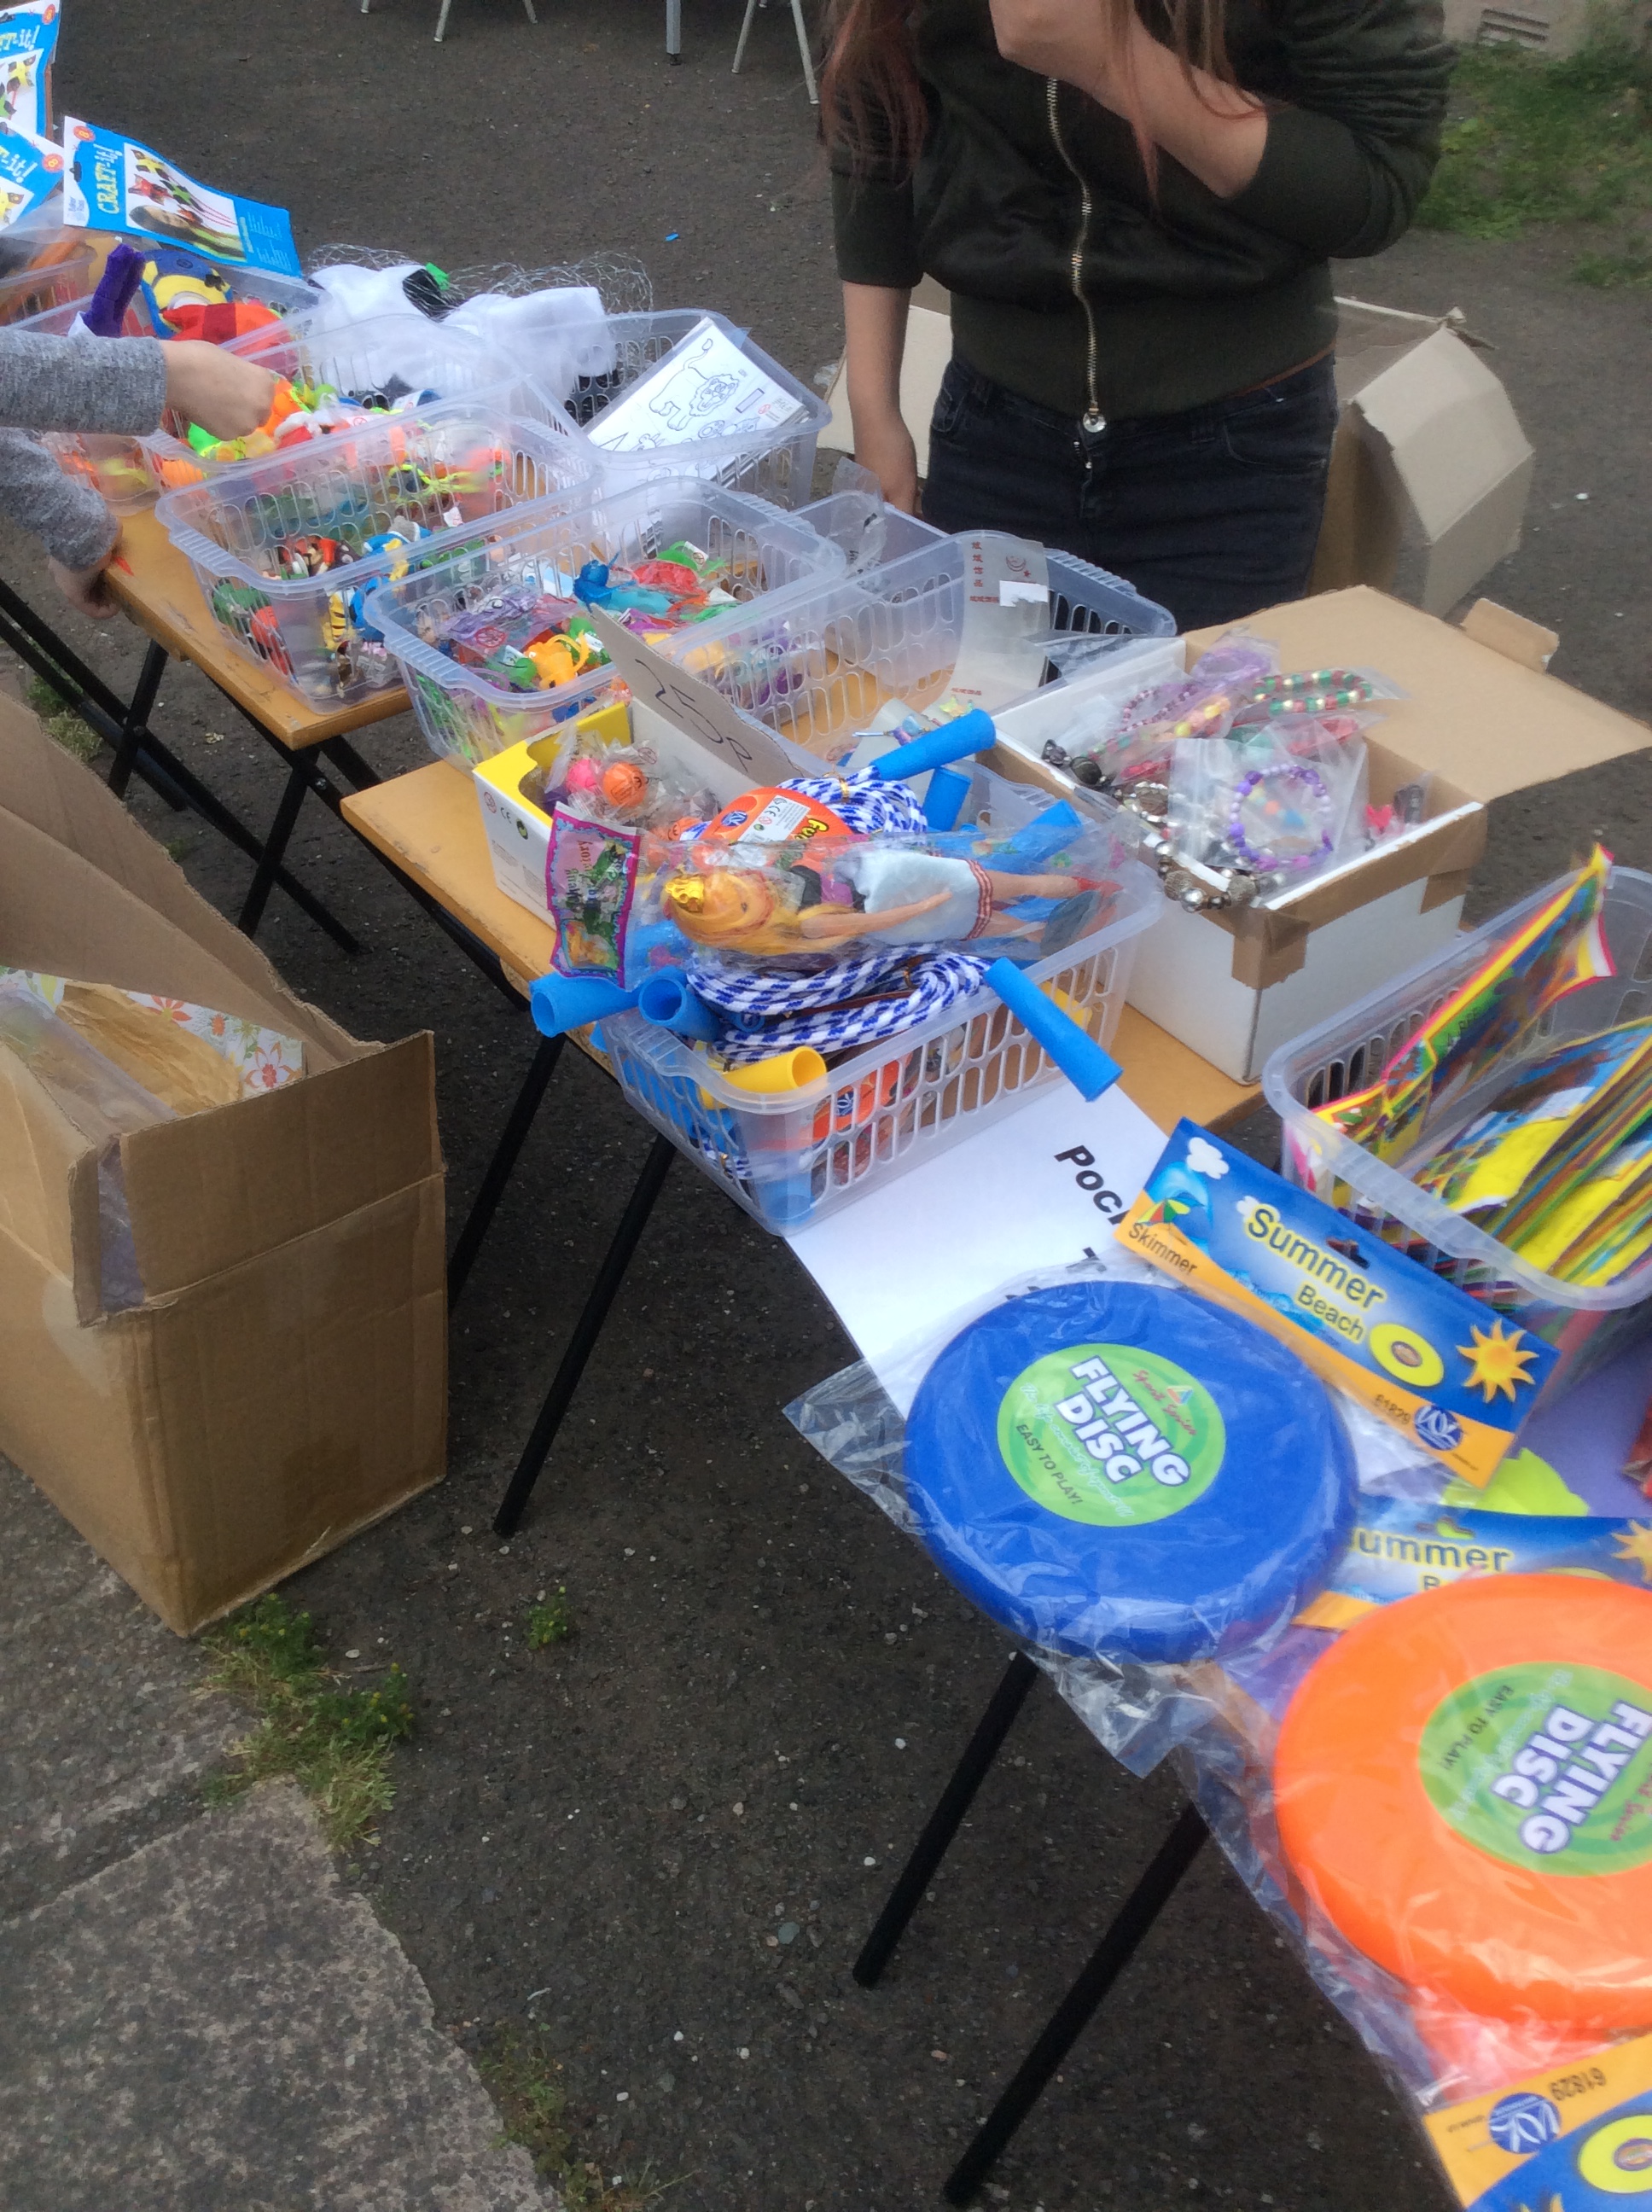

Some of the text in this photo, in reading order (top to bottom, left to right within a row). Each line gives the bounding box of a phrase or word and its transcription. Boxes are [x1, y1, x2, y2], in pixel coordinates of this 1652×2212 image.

[1127, 1221, 1198, 1277] Skimmer
[1247, 1208, 1384, 1308] Summer
[1297, 1284, 1365, 1342] Beach
[1015, 1423, 1084, 1505] EASY TO PLAY!
[1054, 1390, 1144, 1485] DISC
[1069, 1354, 1191, 1487] FLYING
[1353, 1530, 1511, 1572] ummer
[1489, 1703, 1596, 1810] DISC
[1518, 1699, 1652, 1854] FLYING
